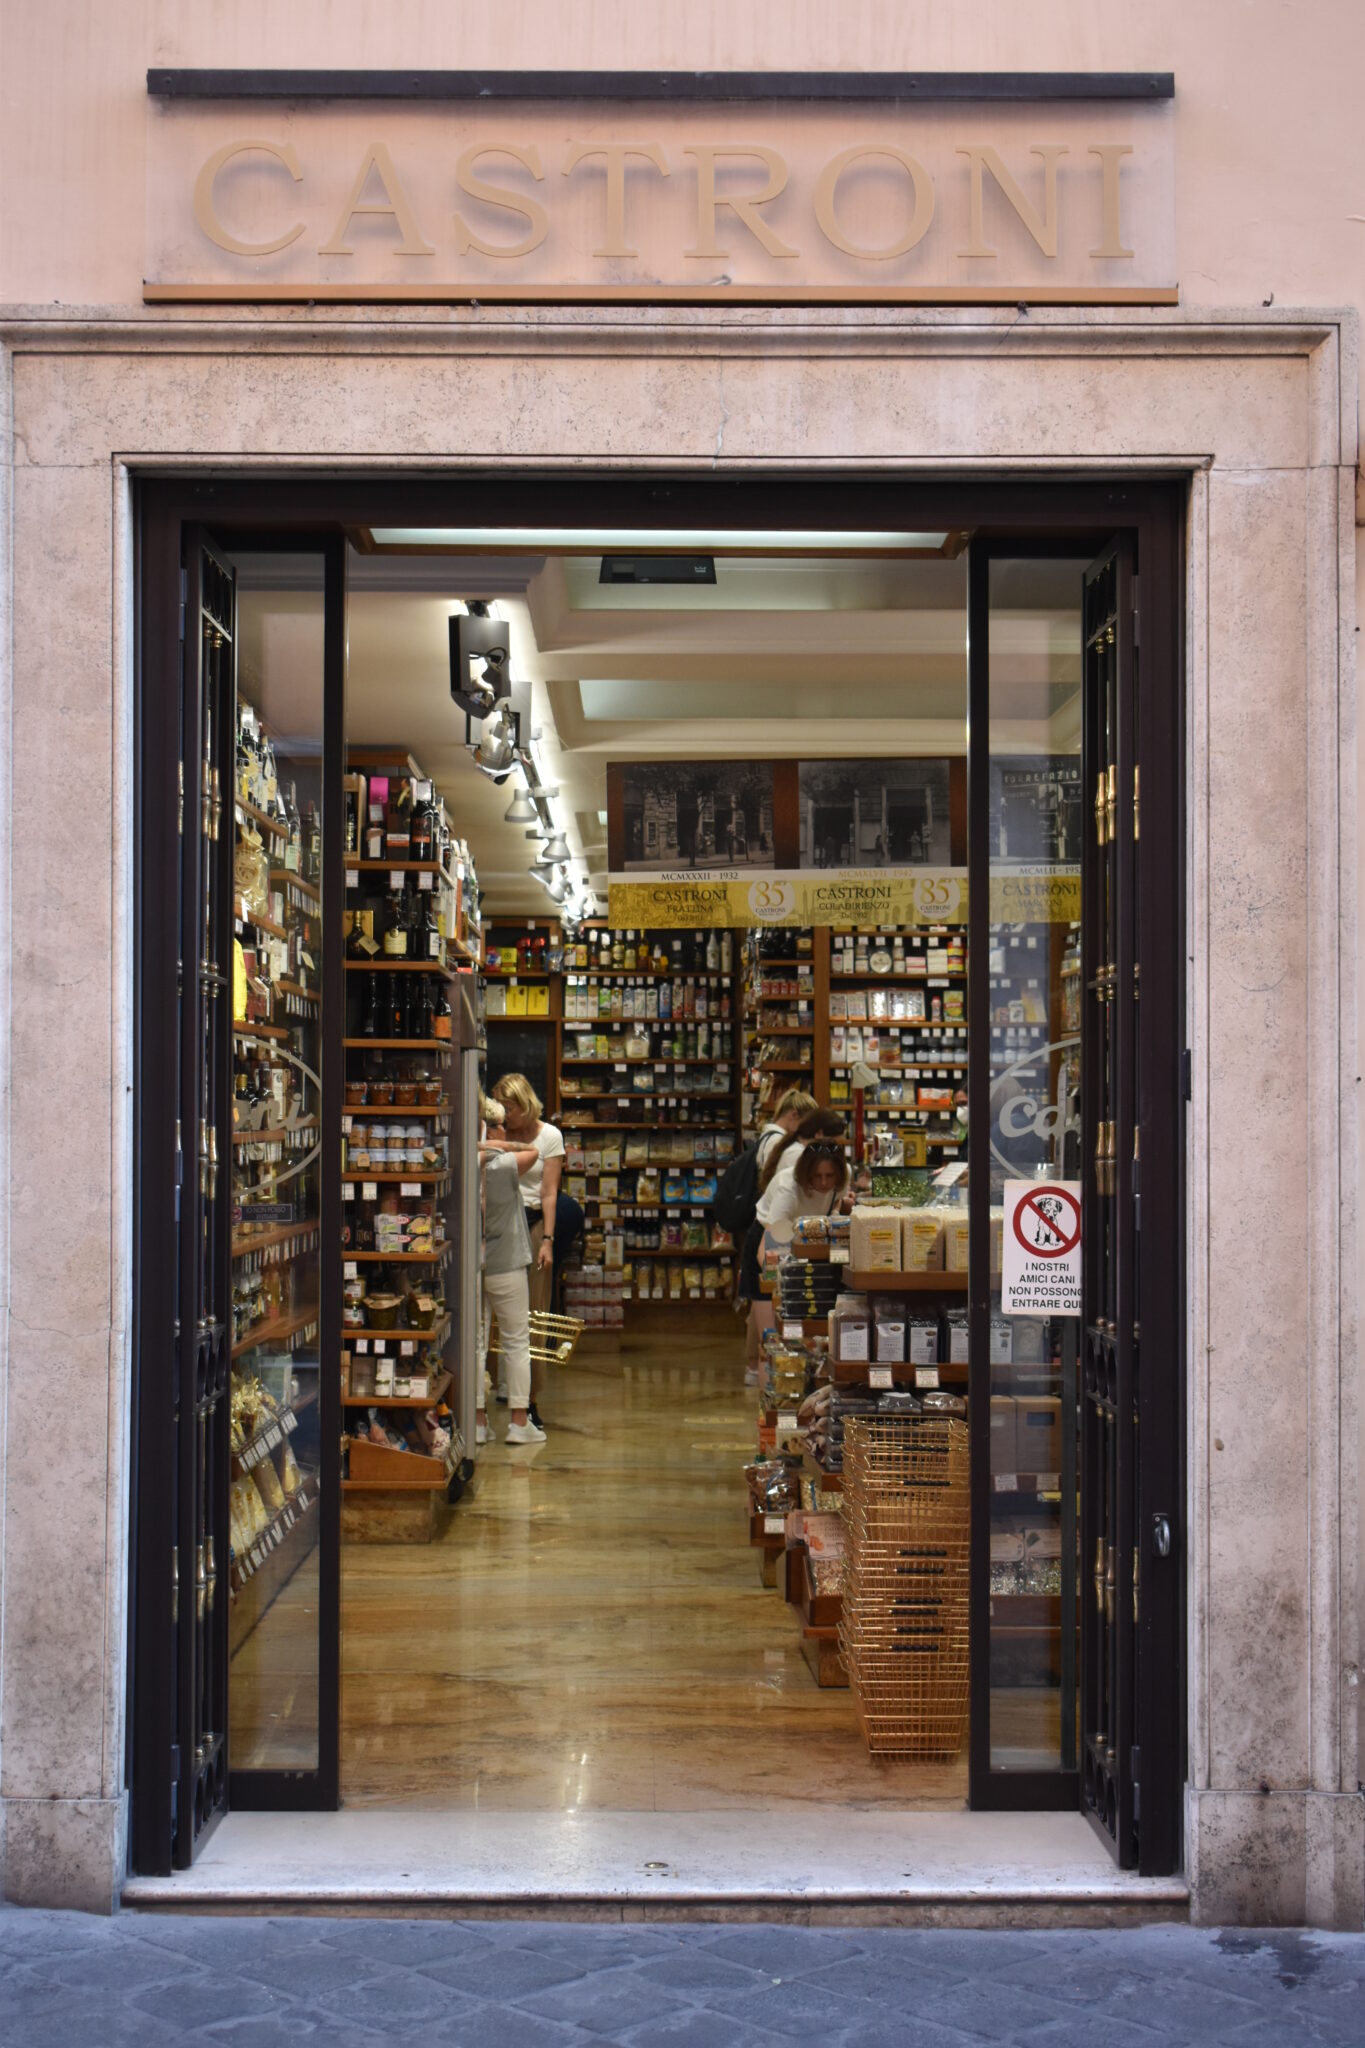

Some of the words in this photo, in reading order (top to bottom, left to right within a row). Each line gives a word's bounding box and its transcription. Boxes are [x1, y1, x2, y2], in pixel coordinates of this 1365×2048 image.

[197, 139, 1135, 260] CASTRONI
[661, 872, 711, 881] MCMXXXII
[719, 871, 738, 880] 1932
[653, 889, 727, 901] CASTRONI
[817, 887, 891, 899] CASTRONI
[1002, 883, 1077, 897] CASTRONI
[666, 904, 713, 913] FRATTINA
[1025, 1262, 1028, 1271] I
[1031, 1262, 1069, 1271] NOSTRI
[1019, 1274, 1048, 1284] AMICI
[1050, 1275, 1075, 1284] CANI
[1009, 1286, 1031, 1295] NON
[1012, 1299, 1061, 1308] ENTRARE
